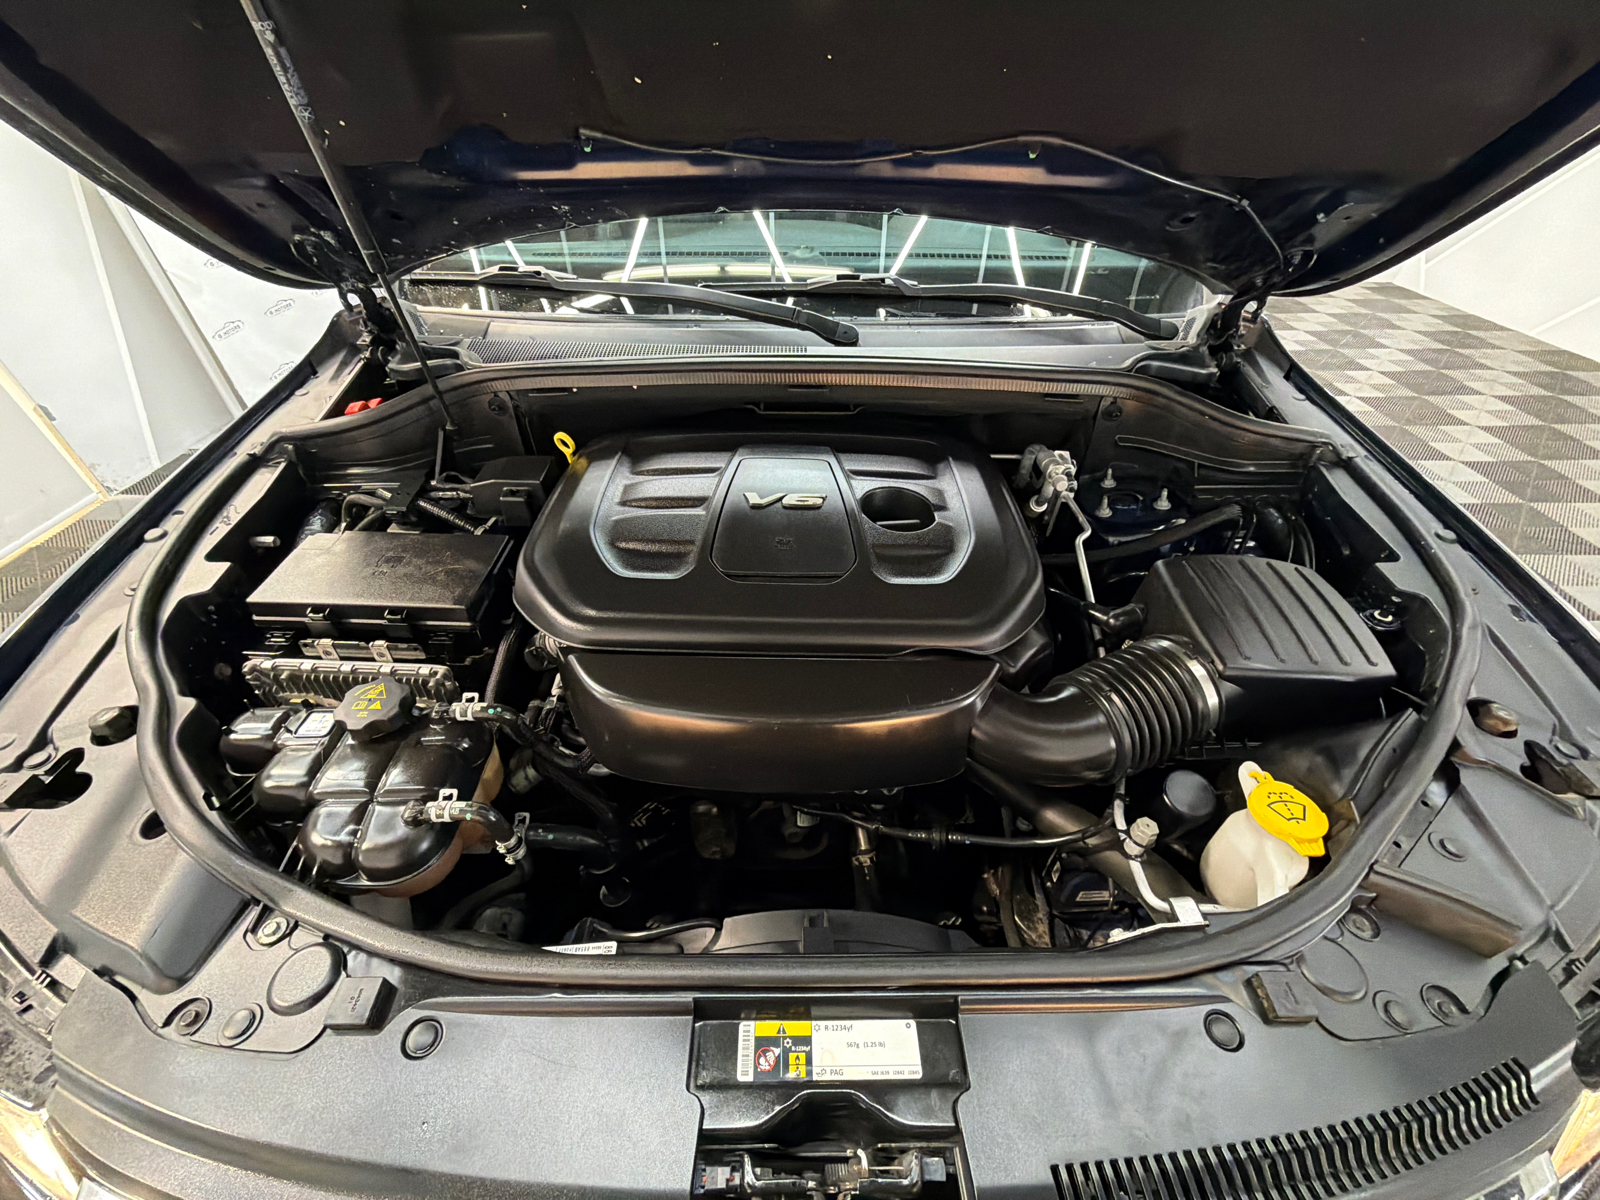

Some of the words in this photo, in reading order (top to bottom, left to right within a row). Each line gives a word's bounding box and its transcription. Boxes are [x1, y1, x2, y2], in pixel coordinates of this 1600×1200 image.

[743, 491, 828, 510] V6
[824, 1023, 854, 1033] R-1234yf
[846, 1041, 860, 1049] 567g
[863, 1041, 878, 1049] (1.25
[878, 1041, 886, 1049] lb)
